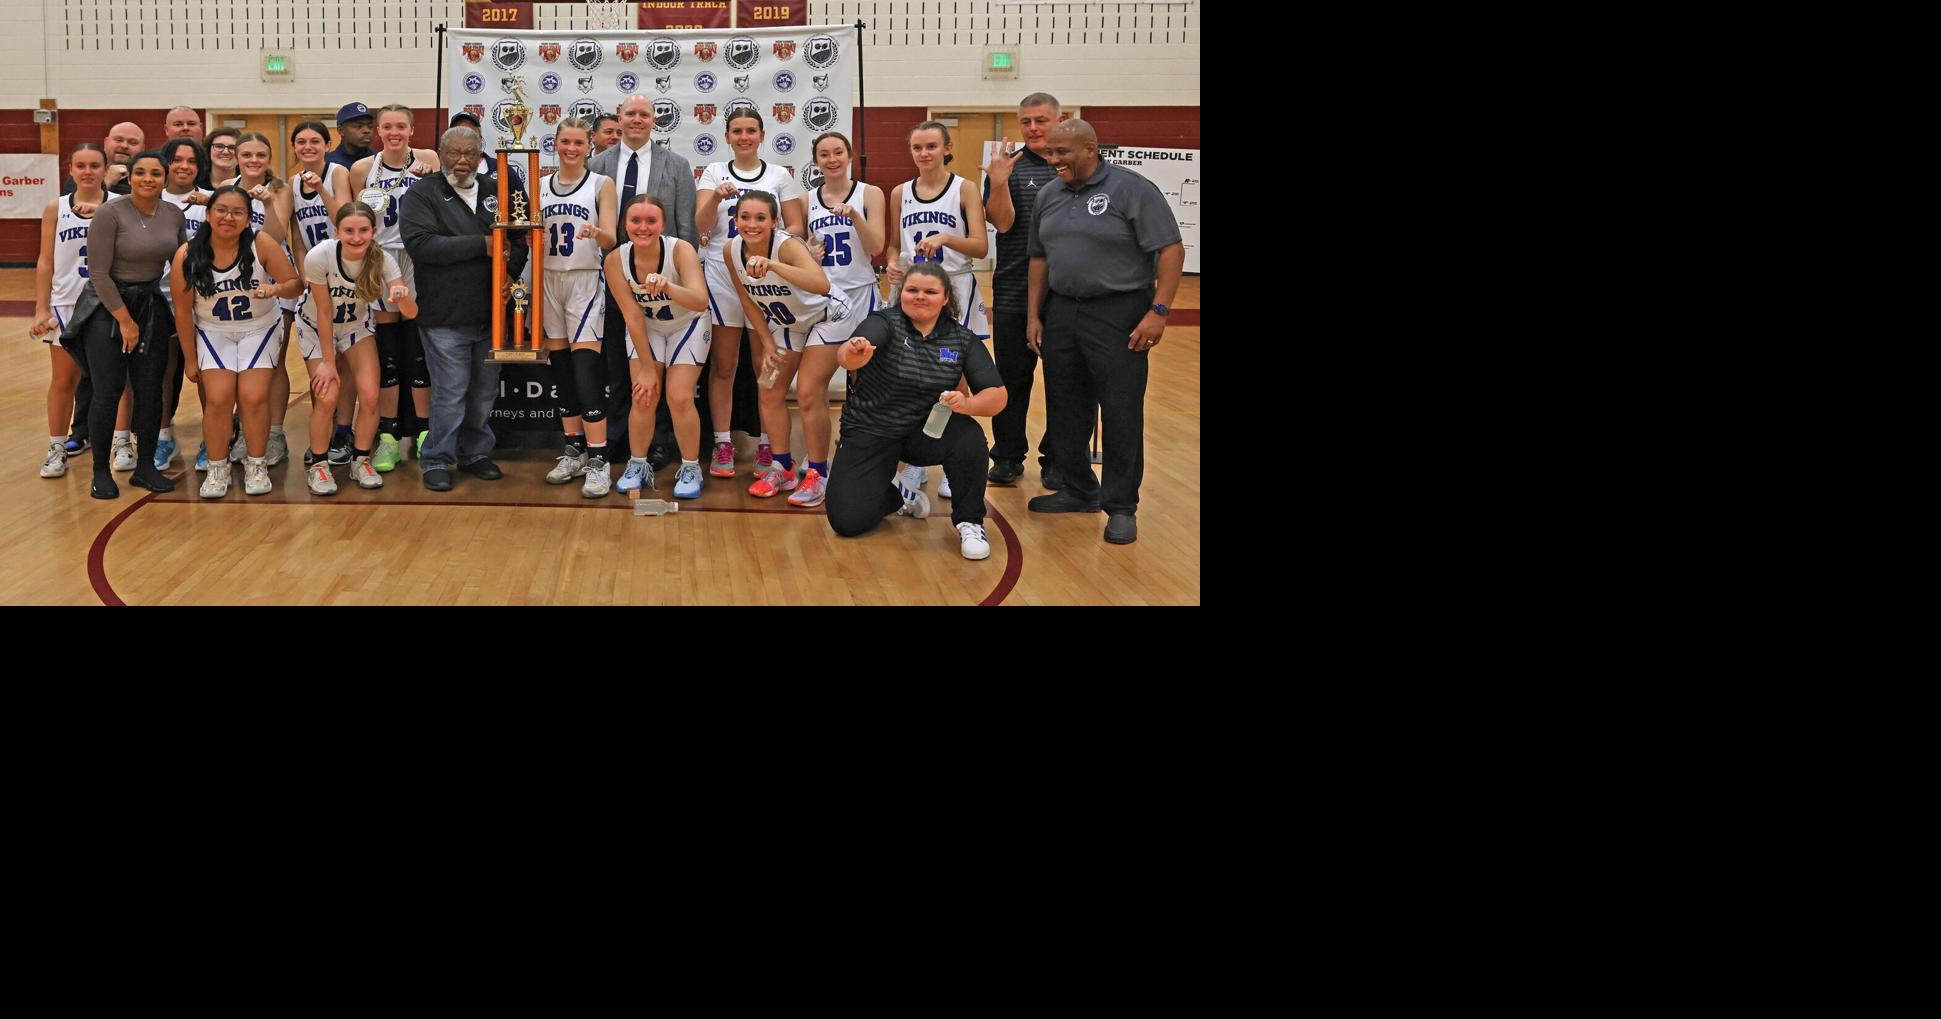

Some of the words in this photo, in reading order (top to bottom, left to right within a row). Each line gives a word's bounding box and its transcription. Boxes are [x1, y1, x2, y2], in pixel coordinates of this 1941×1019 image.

[482, 8, 518, 22] 2017
[753, 6, 790, 20] 2019
[1127, 150, 1193, 161] SCHEDULE
[3, 176, 45, 186] Garber
[808, 215, 854, 234] VIKING
[902, 211, 957, 229] VIKINGS
[59, 226, 89, 243] VIKI
[548, 222, 576, 257] 13
[821, 231, 853, 267] 25
[212, 295, 253, 322] 42
[529, 408, 554, 419] and
